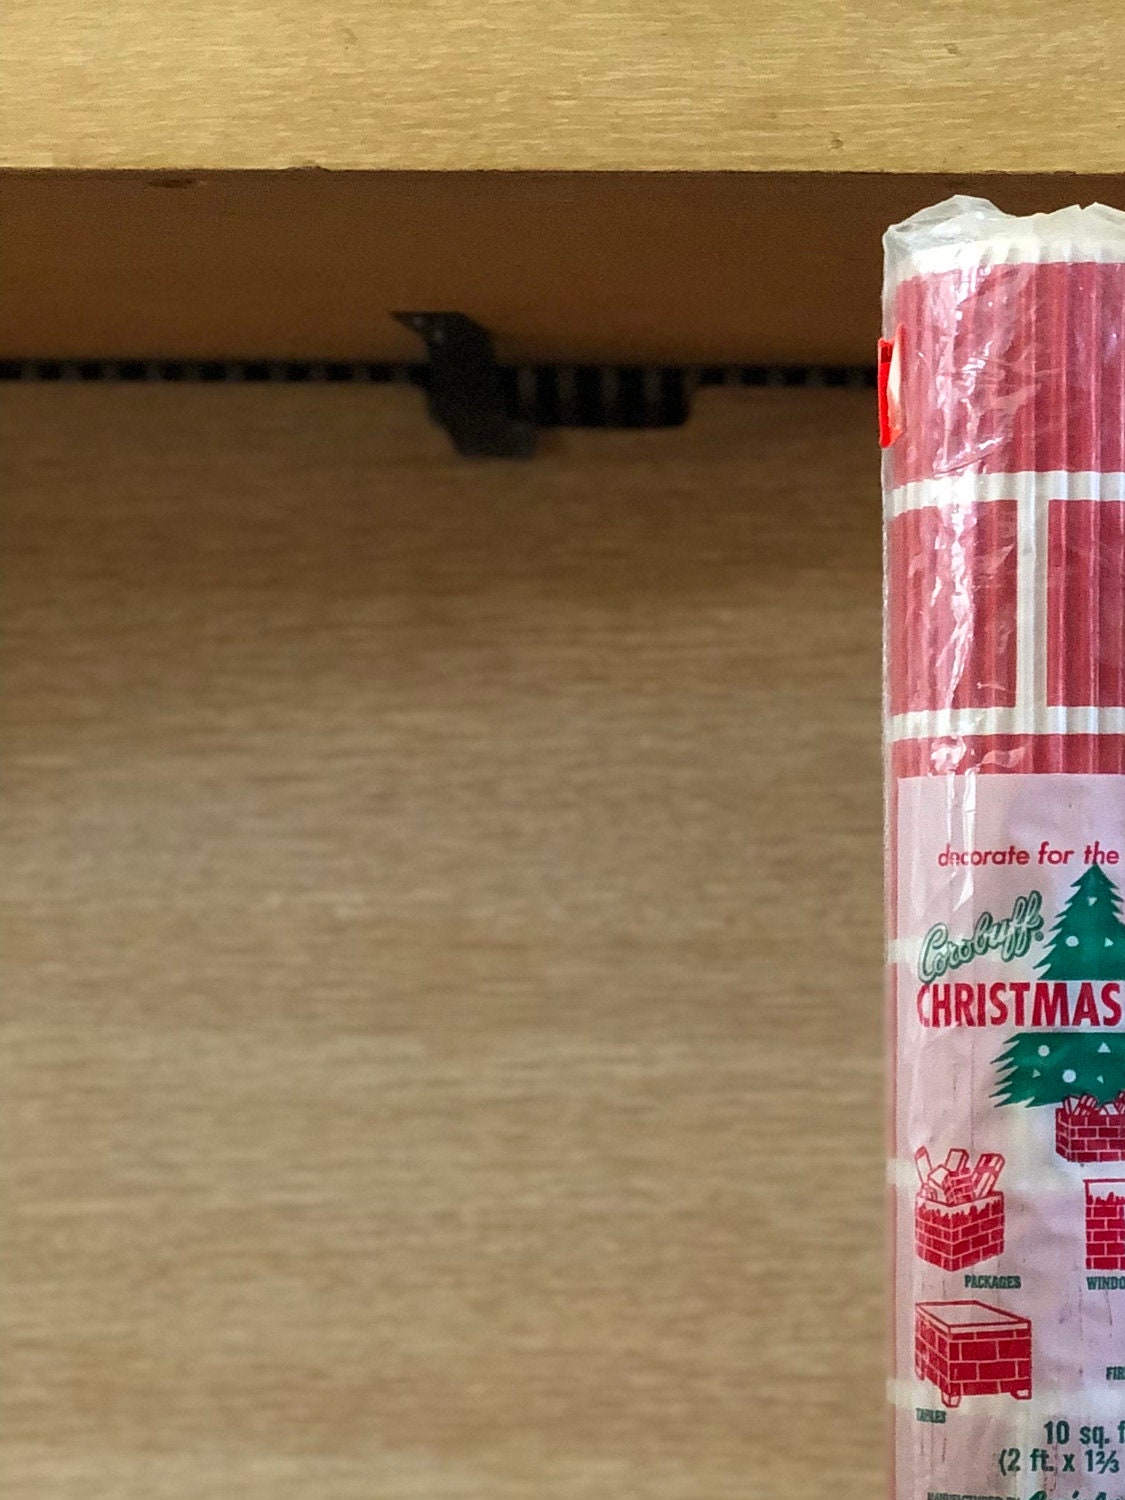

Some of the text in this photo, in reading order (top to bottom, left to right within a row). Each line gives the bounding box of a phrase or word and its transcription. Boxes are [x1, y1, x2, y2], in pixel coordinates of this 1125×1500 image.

[937, 843, 1030, 867] decorate
[1038, 841, 1074, 866] for
[1084, 841, 1119, 865] the
[916, 981, 1122, 1028] CHRISTMAS
[964, 1275, 1021, 1289] PACKAGES
[1044, 1420, 1070, 1445] 10
[1079, 1426, 1111, 1449] sq.
[999, 1448, 1021, 1476] (2
[1031, 1448, 1056, 1472] ft.
[1062, 1454, 1075, 1472] x
